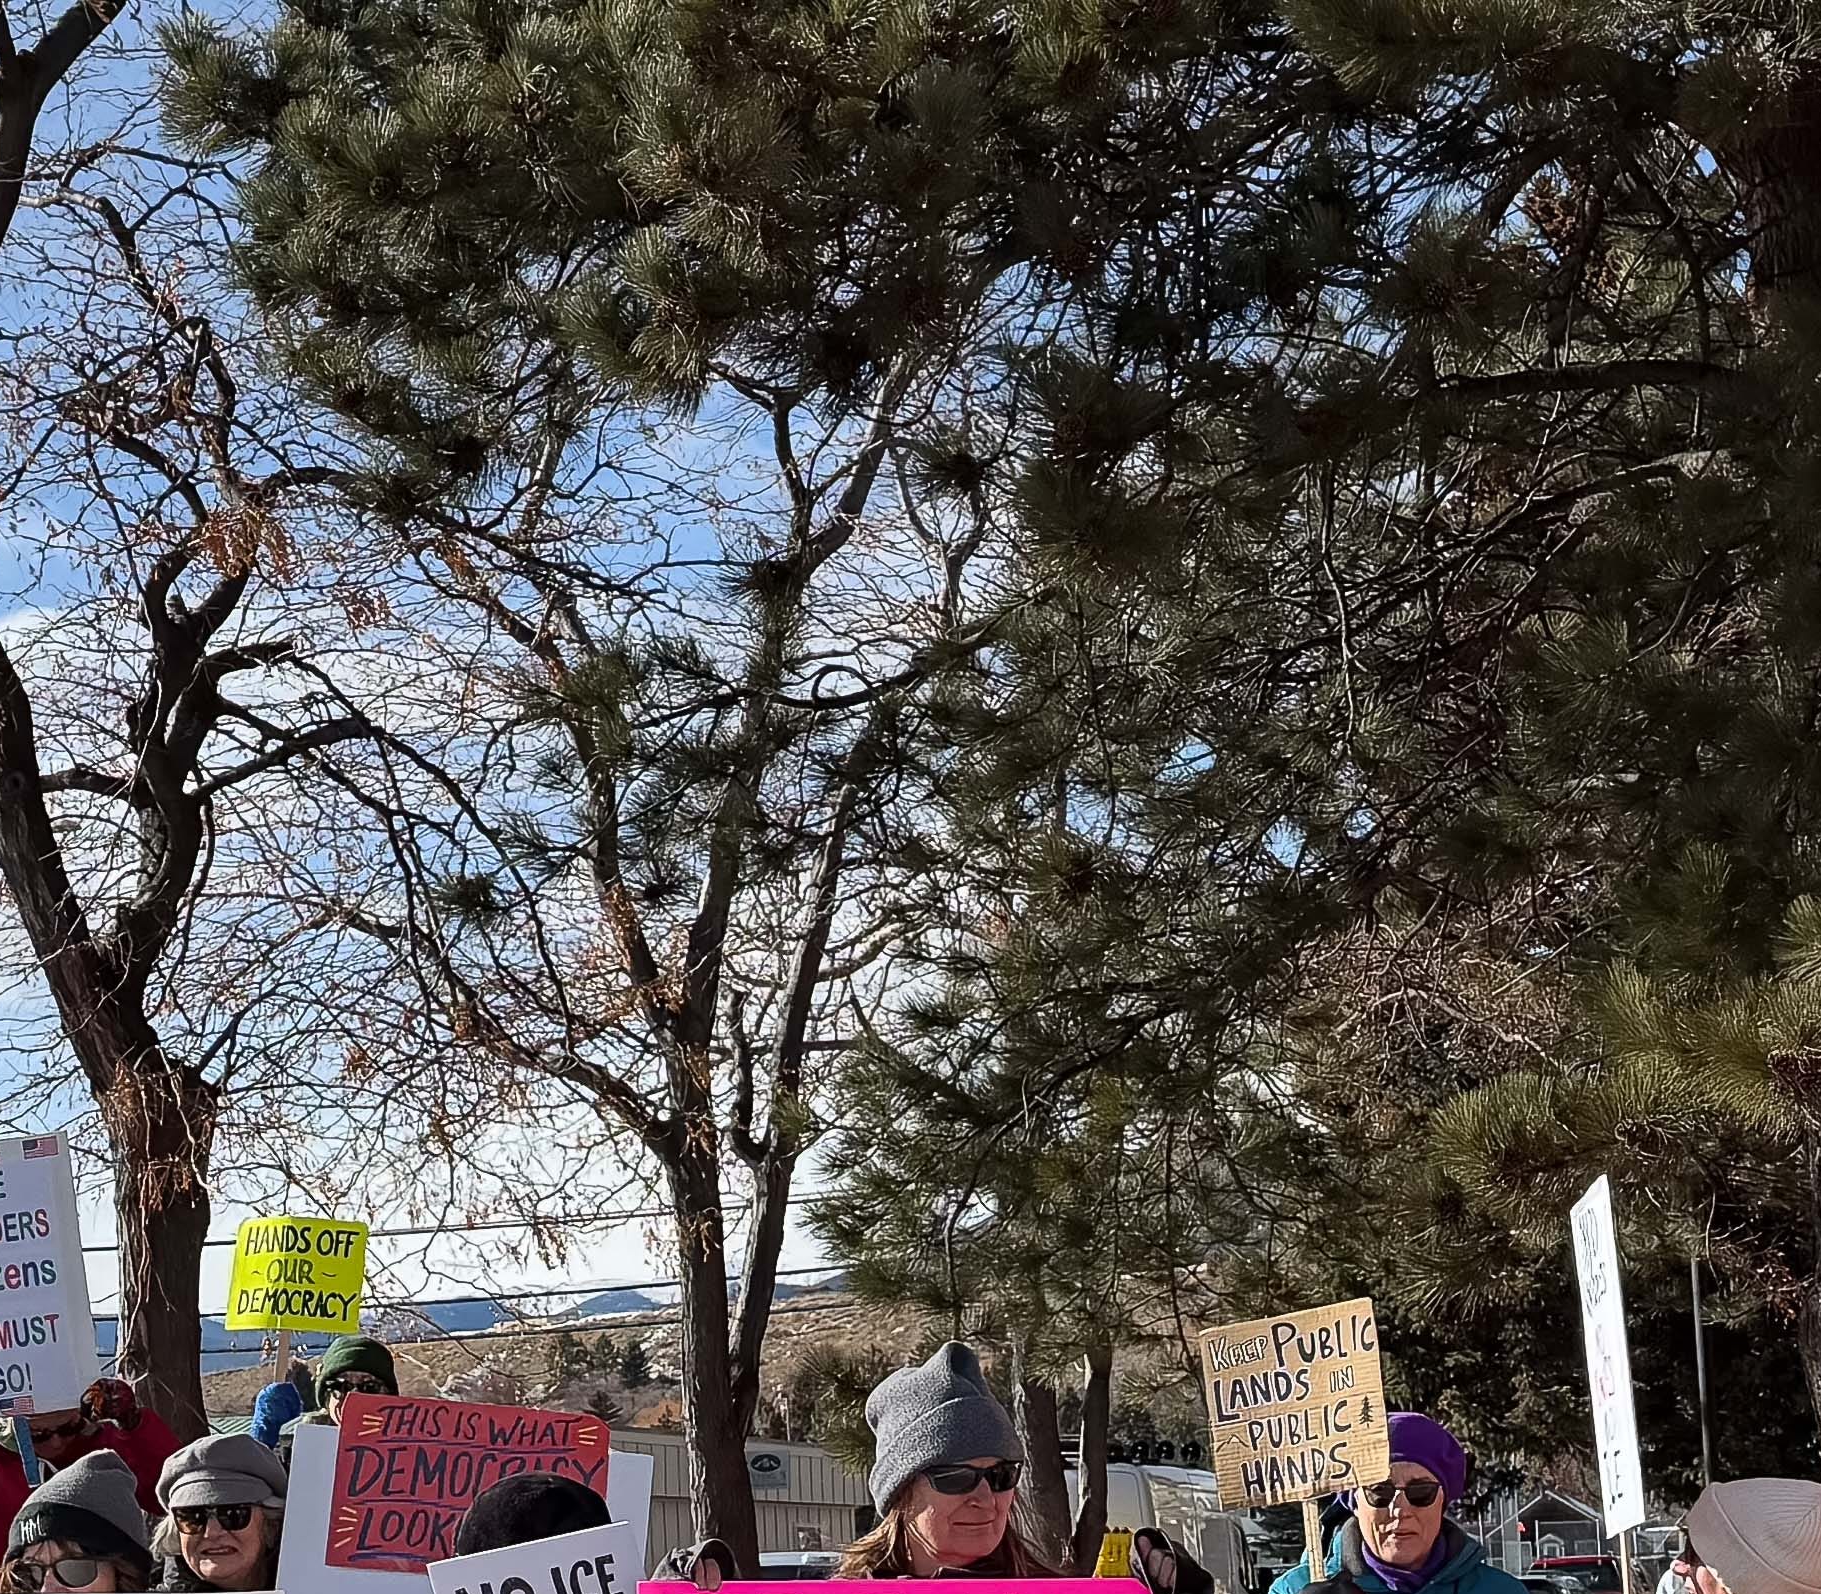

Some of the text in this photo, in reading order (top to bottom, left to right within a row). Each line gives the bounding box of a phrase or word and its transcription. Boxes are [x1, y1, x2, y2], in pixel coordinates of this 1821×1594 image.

[245, 1225, 361, 1258] HANDS OFF
[237, 1287, 357, 1321] DEMOCRACY
[1271, 1315, 1375, 1367] PUBLIC
[1213, 1365, 1354, 1423] LANDS IN
[377, 1403, 583, 1447] THIS IS WHAT
[1248, 1400, 1352, 1451] PUBLIC
[344, 1445, 606, 1500] DEMOCY
[1241, 1442, 1353, 1497] HANDS
[356, 1507, 460, 1558] LOOK
